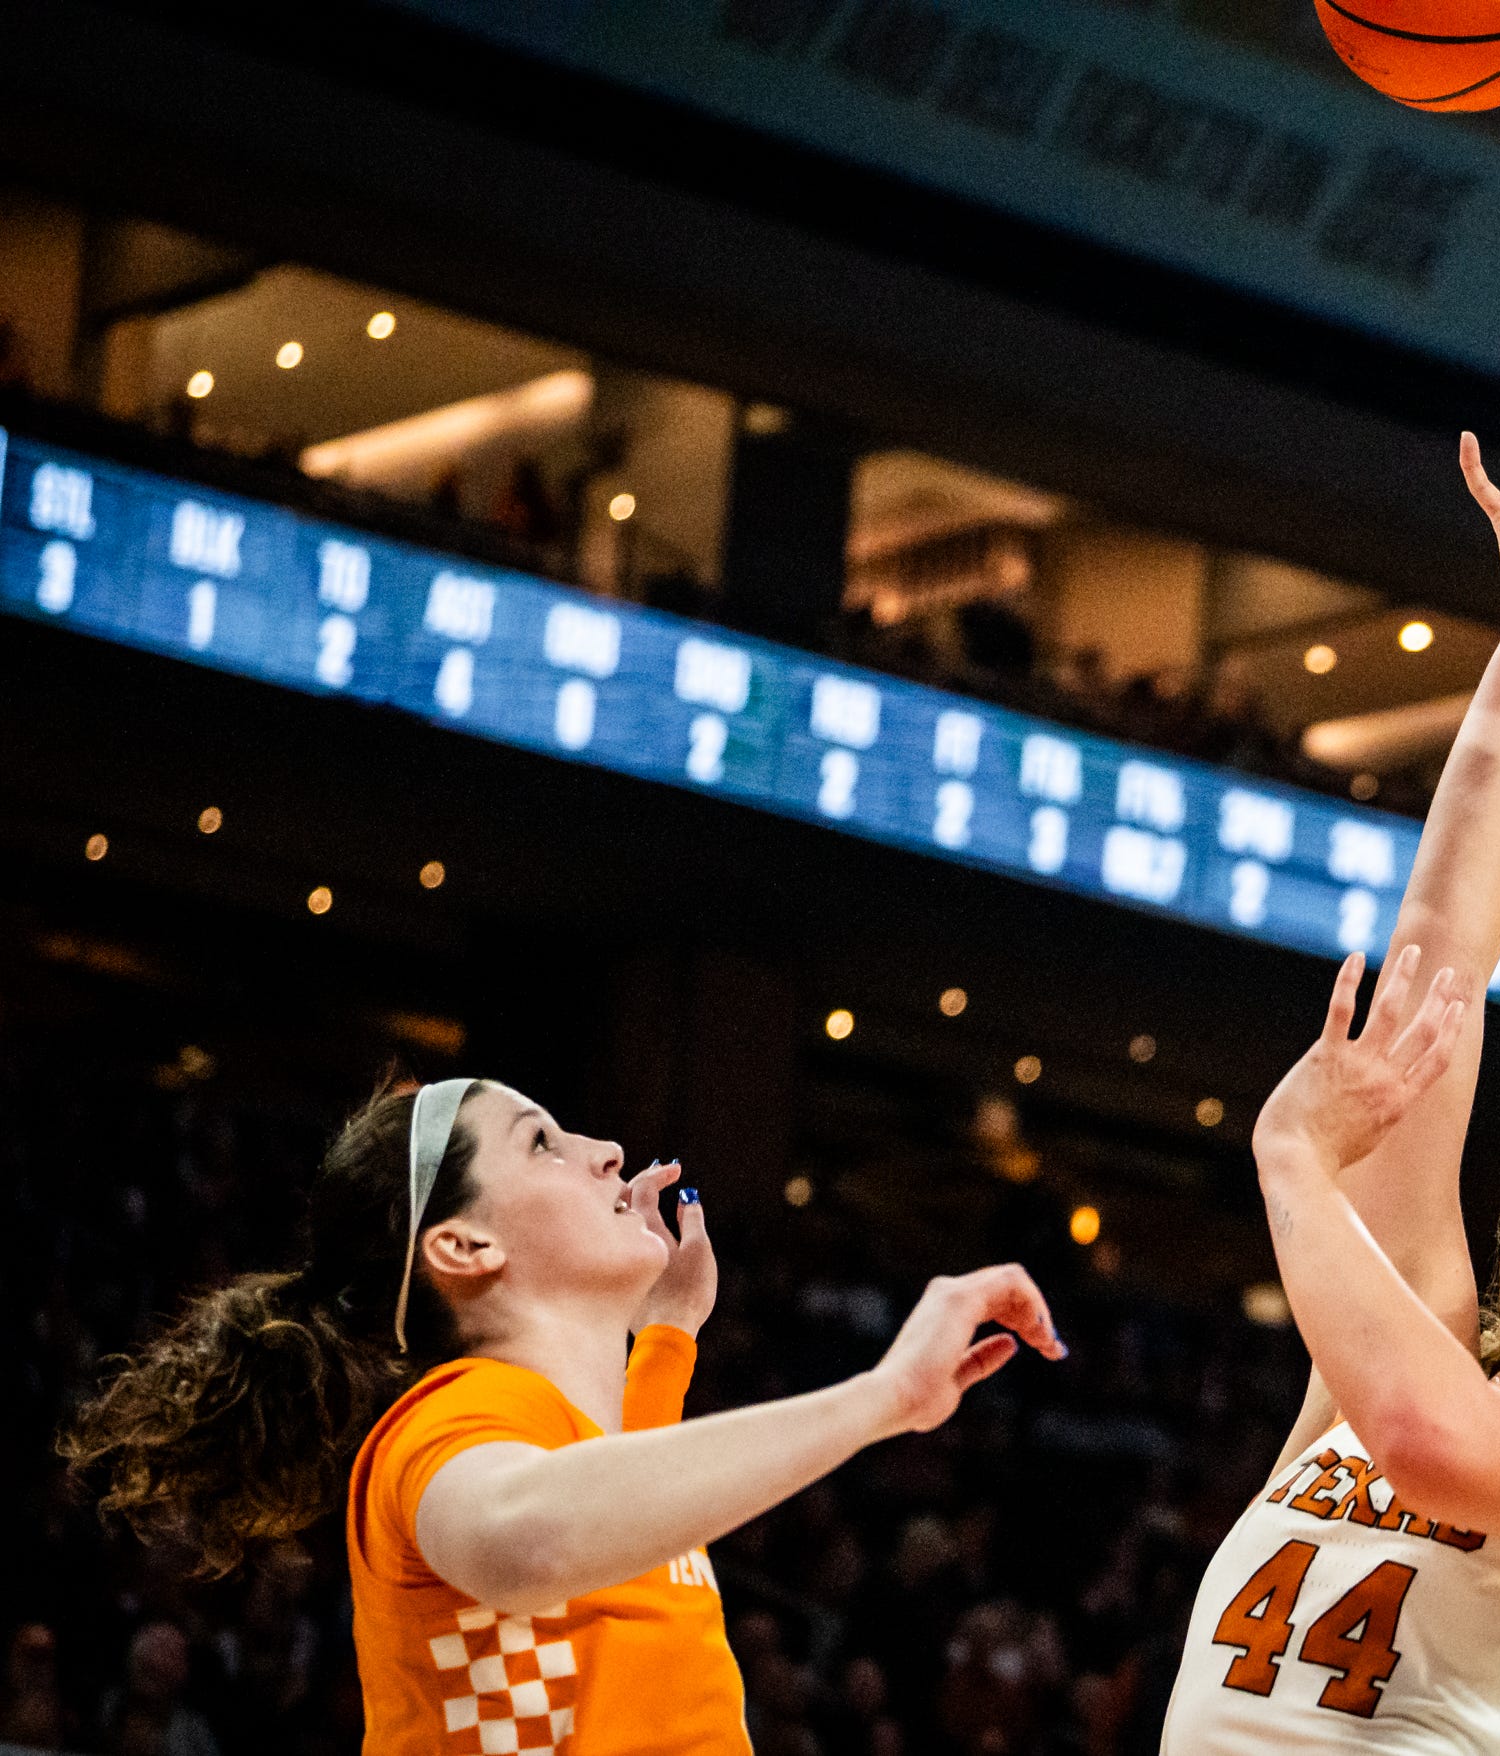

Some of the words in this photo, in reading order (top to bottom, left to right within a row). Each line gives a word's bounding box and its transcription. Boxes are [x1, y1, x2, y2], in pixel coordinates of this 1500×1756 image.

[33, 462, 96, 540] STL
[171, 501, 243, 576] BLK
[188, 580, 218, 651] 1
[316, 613, 357, 687] 2
[686, 713, 728, 784] 2
[817, 748, 859, 818] 2
[933, 779, 975, 849] 2
[1211, 1538, 1419, 1719] 44
